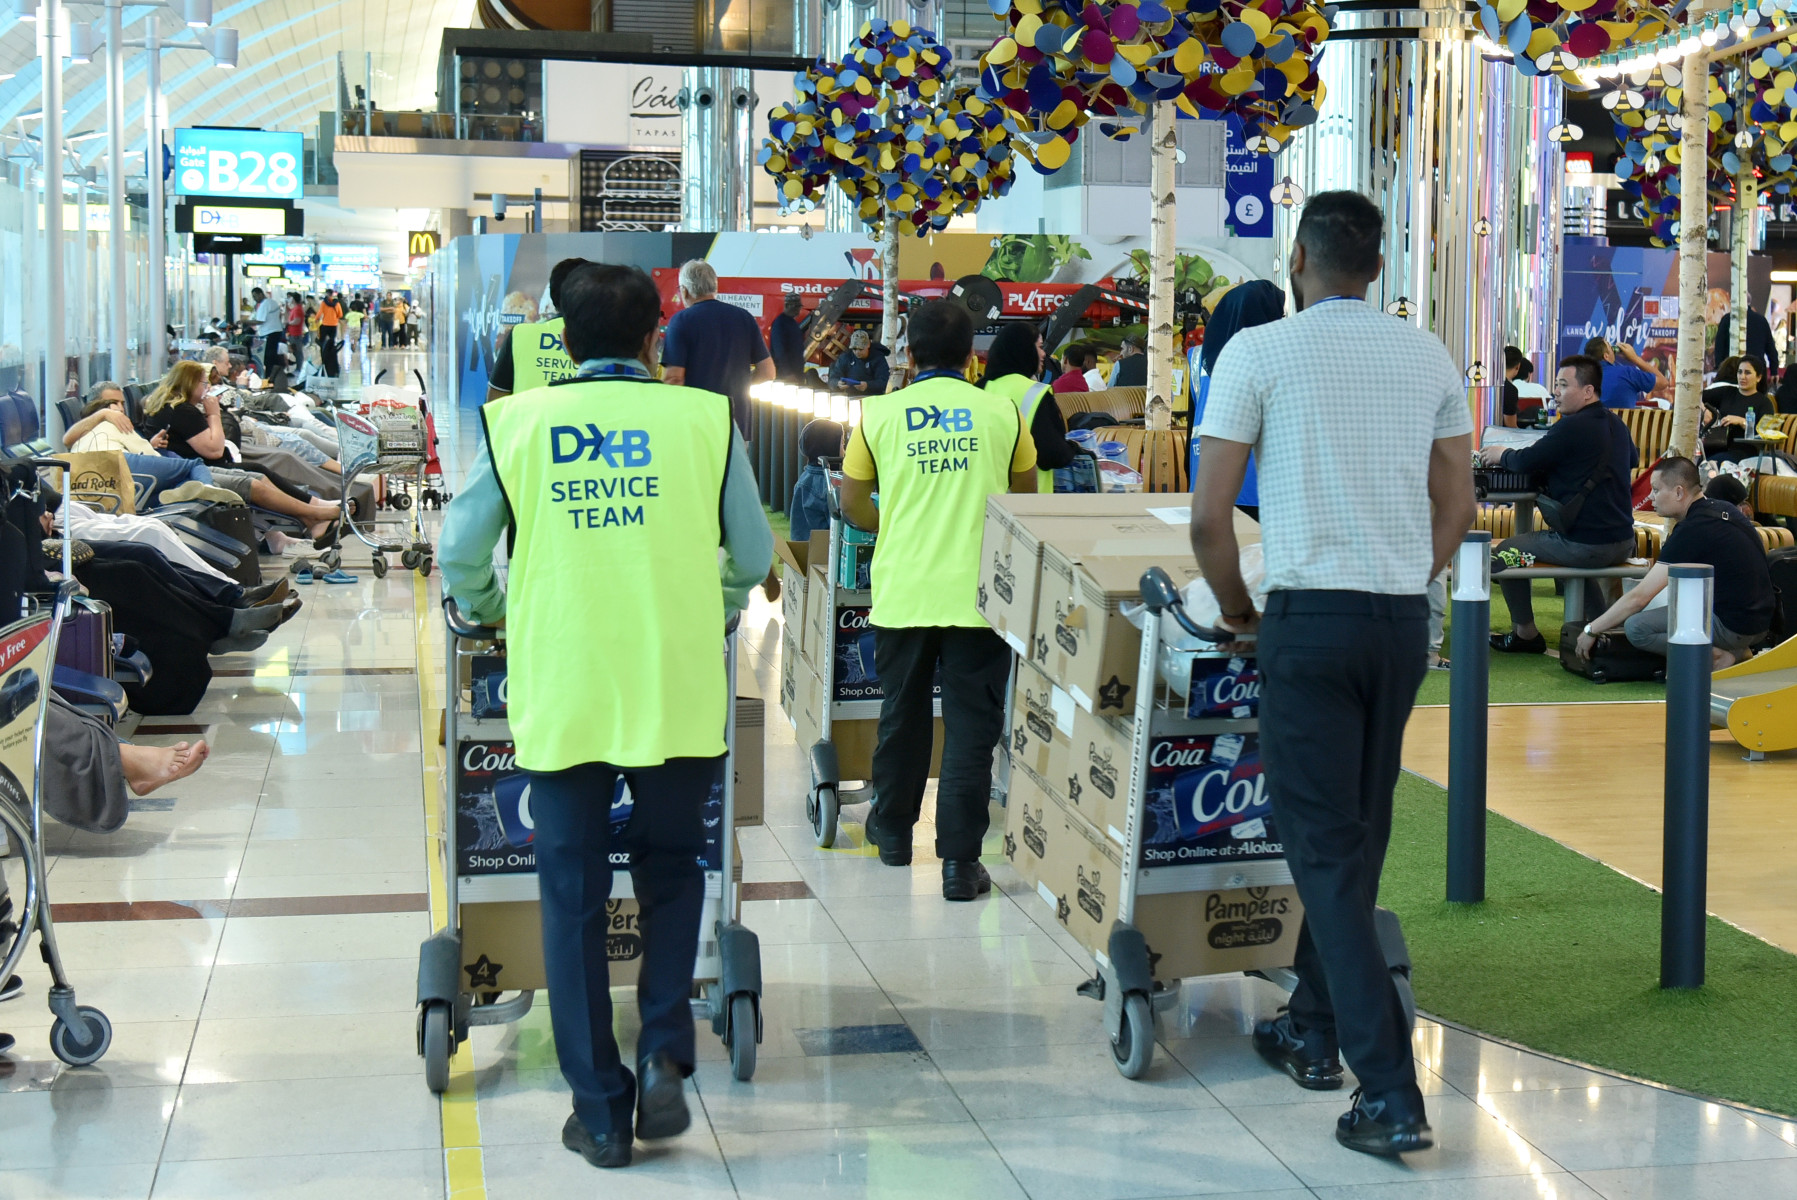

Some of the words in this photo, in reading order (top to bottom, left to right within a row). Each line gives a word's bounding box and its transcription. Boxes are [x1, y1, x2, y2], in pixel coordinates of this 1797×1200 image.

[637, 129, 677, 137] TAPAS
[180, 157, 206, 168] Gate
[208, 150, 298, 194] B28
[727, 294, 753, 302] HEAVY
[1008, 289, 1067, 311] PLATFO
[1651, 328, 1676, 336] TAKEOFF
[536, 357, 580, 370] SERVI
[905, 405, 974, 433] DXB
[550, 423, 652, 468] DXB
[907, 437, 979, 457] SERVICE
[917, 457, 968, 474] TEAM
[71, 478, 89, 490] ard
[91, 476, 116, 490] Rock
[551, 476, 660, 503] SERVICE
[568, 505, 644, 529] TEAM
[839, 608, 870, 629] Col
[6, 637, 27, 660] Free
[839, 687, 863, 697] Shop
[1106, 683, 1119, 699] 4
[1150, 739, 1206, 768] Cola
[1192, 768, 1269, 823] Col
[469, 855, 504, 869] Shop
[508, 853, 536, 866] Onli
[1145, 848, 1176, 862] Shop
[1178, 845, 1217, 858] Online
[1238, 840, 1284, 856] Alokoz
[1206, 893, 1289, 922] Pampers
[1215, 931, 1245, 946] night
[477, 962, 490, 977] 4
